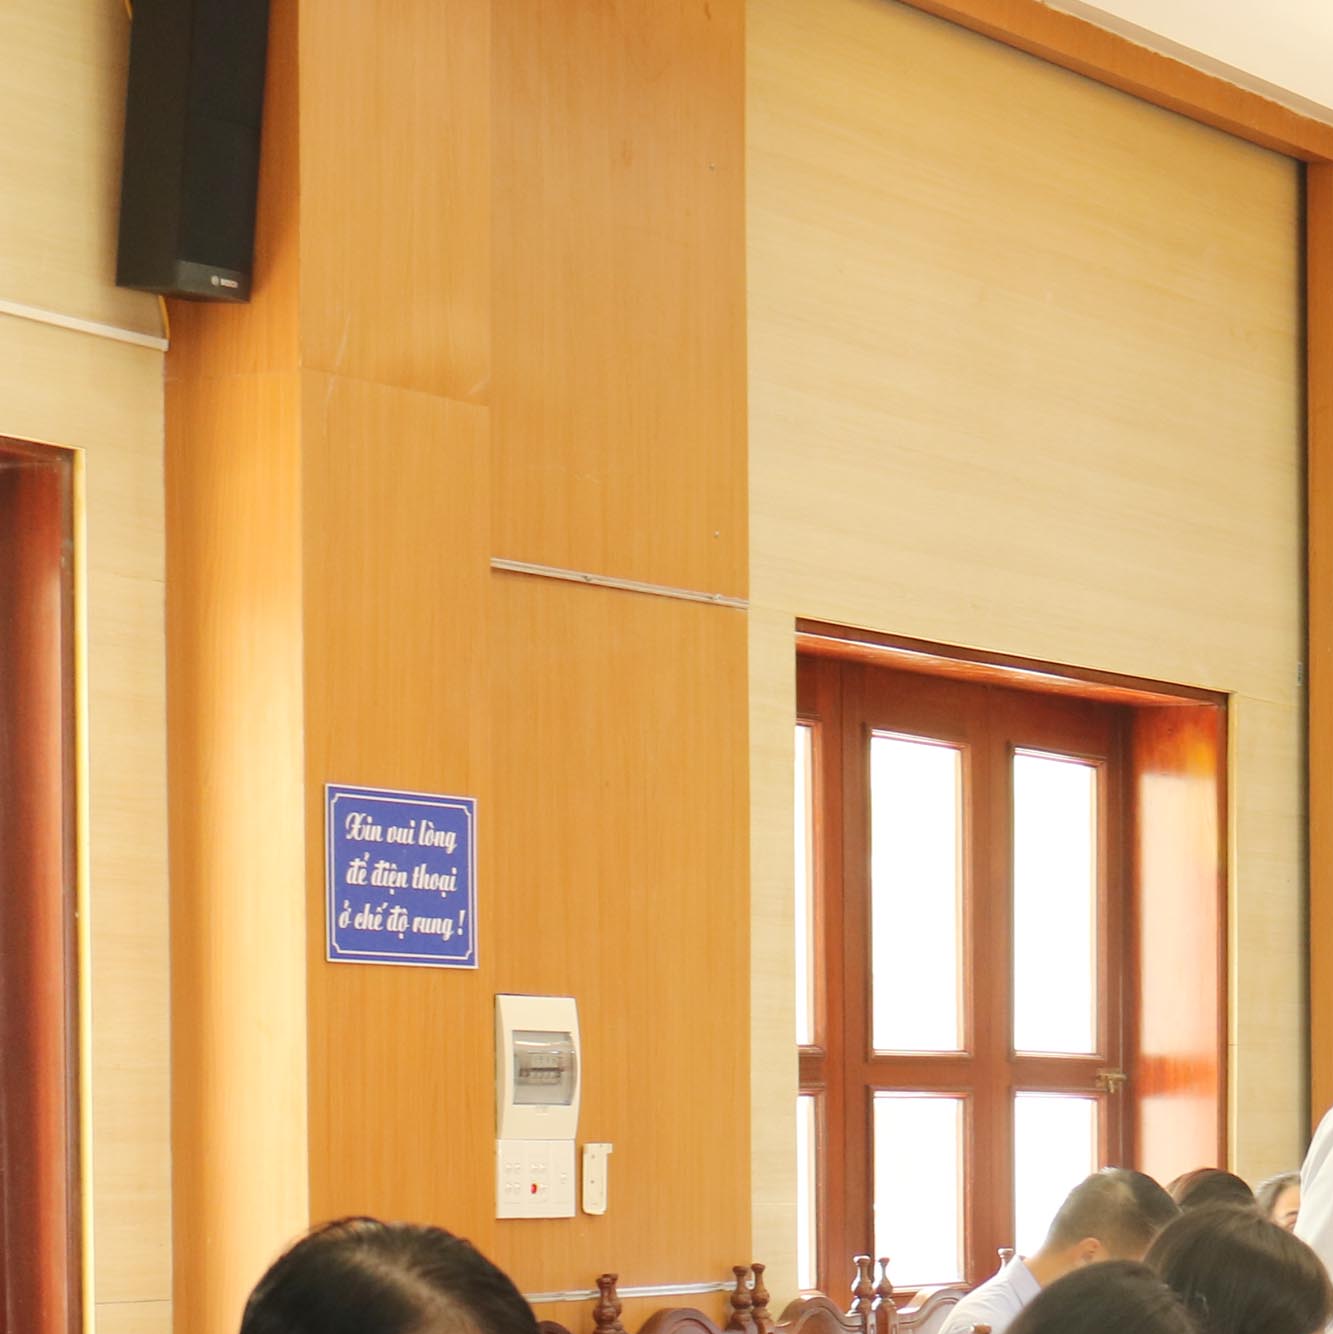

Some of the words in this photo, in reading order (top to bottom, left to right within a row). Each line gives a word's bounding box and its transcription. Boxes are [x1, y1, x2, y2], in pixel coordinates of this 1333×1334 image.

[345, 812, 383, 842] Xin
[418, 819, 457, 854] lòng
[346, 852, 371, 885] để
[371, 860, 409, 895] điện
[412, 863, 457, 898] thoại
[338, 900, 352, 928] ở
[354, 902, 388, 931] chế
[386, 905, 410, 939] độ
[412, 915, 454, 941] rung
